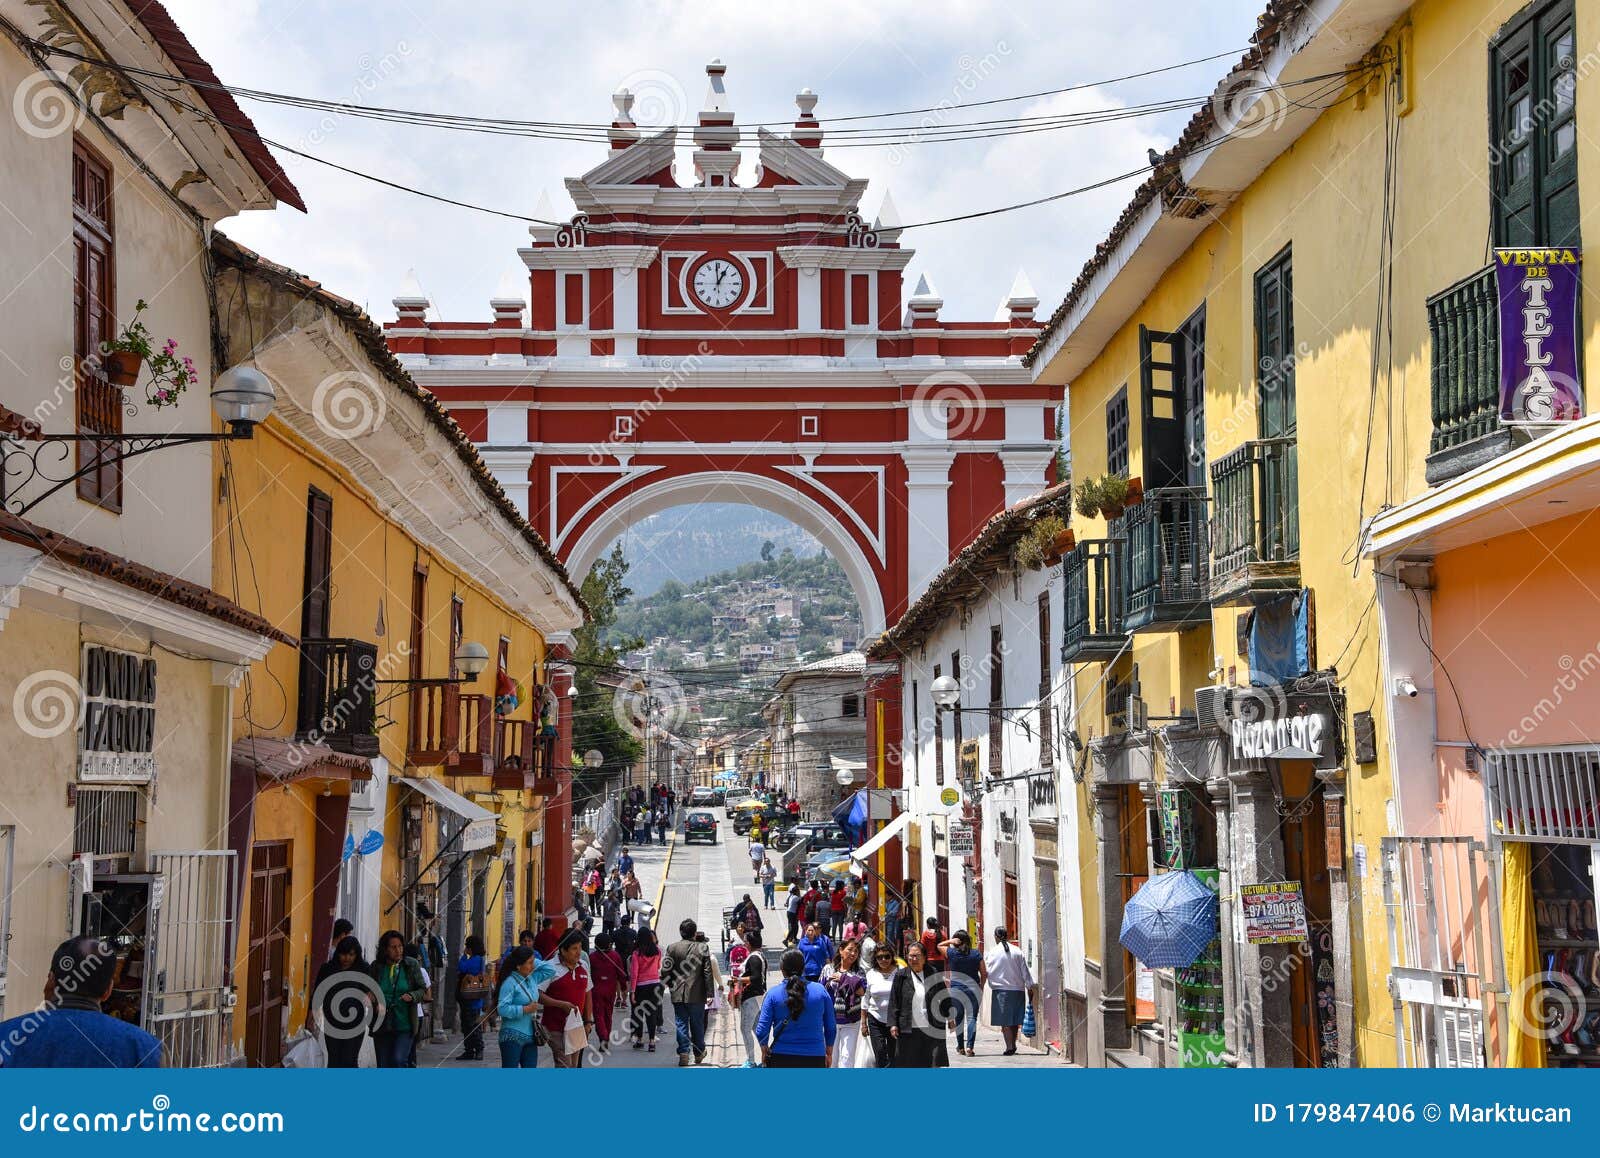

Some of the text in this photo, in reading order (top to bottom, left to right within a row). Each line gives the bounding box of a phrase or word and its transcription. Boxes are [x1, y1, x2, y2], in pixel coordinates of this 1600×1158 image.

[1497, 249, 1577, 265] VENTA
[1526, 267, 1548, 278] DE
[1521, 278, 1557, 422] TELAS
[1241, 885, 1269, 895] LECTURA
[1270, 884, 1278, 893] DE
